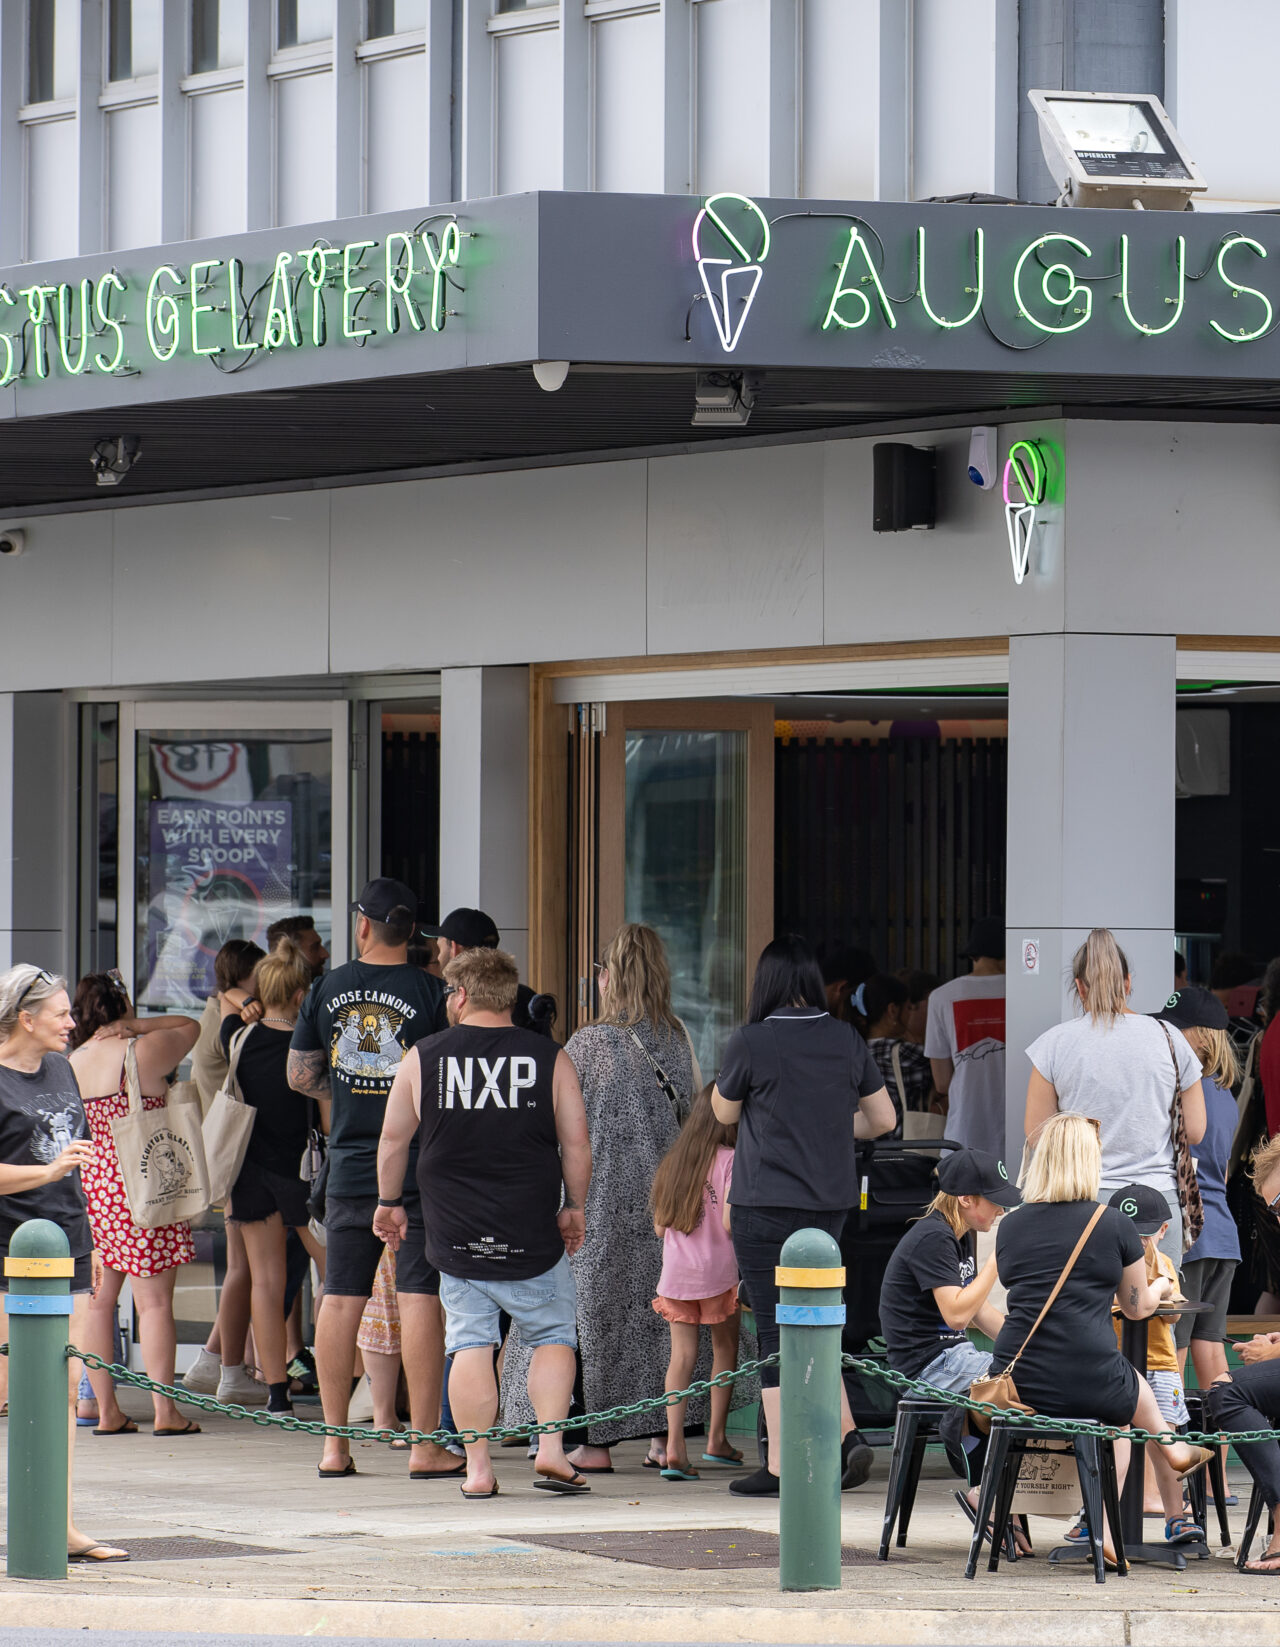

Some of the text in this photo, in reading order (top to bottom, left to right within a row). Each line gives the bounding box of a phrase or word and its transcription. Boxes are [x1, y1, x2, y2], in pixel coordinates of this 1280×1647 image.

[146, 220, 460, 362] GELATERY
[158, 809, 286, 825] EARN POINTS
[162, 829, 282, 844] WITH EVERY
[188, 848, 255, 863] SCOOP
[326, 990, 417, 1020] LOOSE CANNONS
[445, 1056, 537, 1109] NXP
[141, 1133, 165, 1173] AUGUSTUS
[1020, 1482, 1050, 1490] YOURSELF
